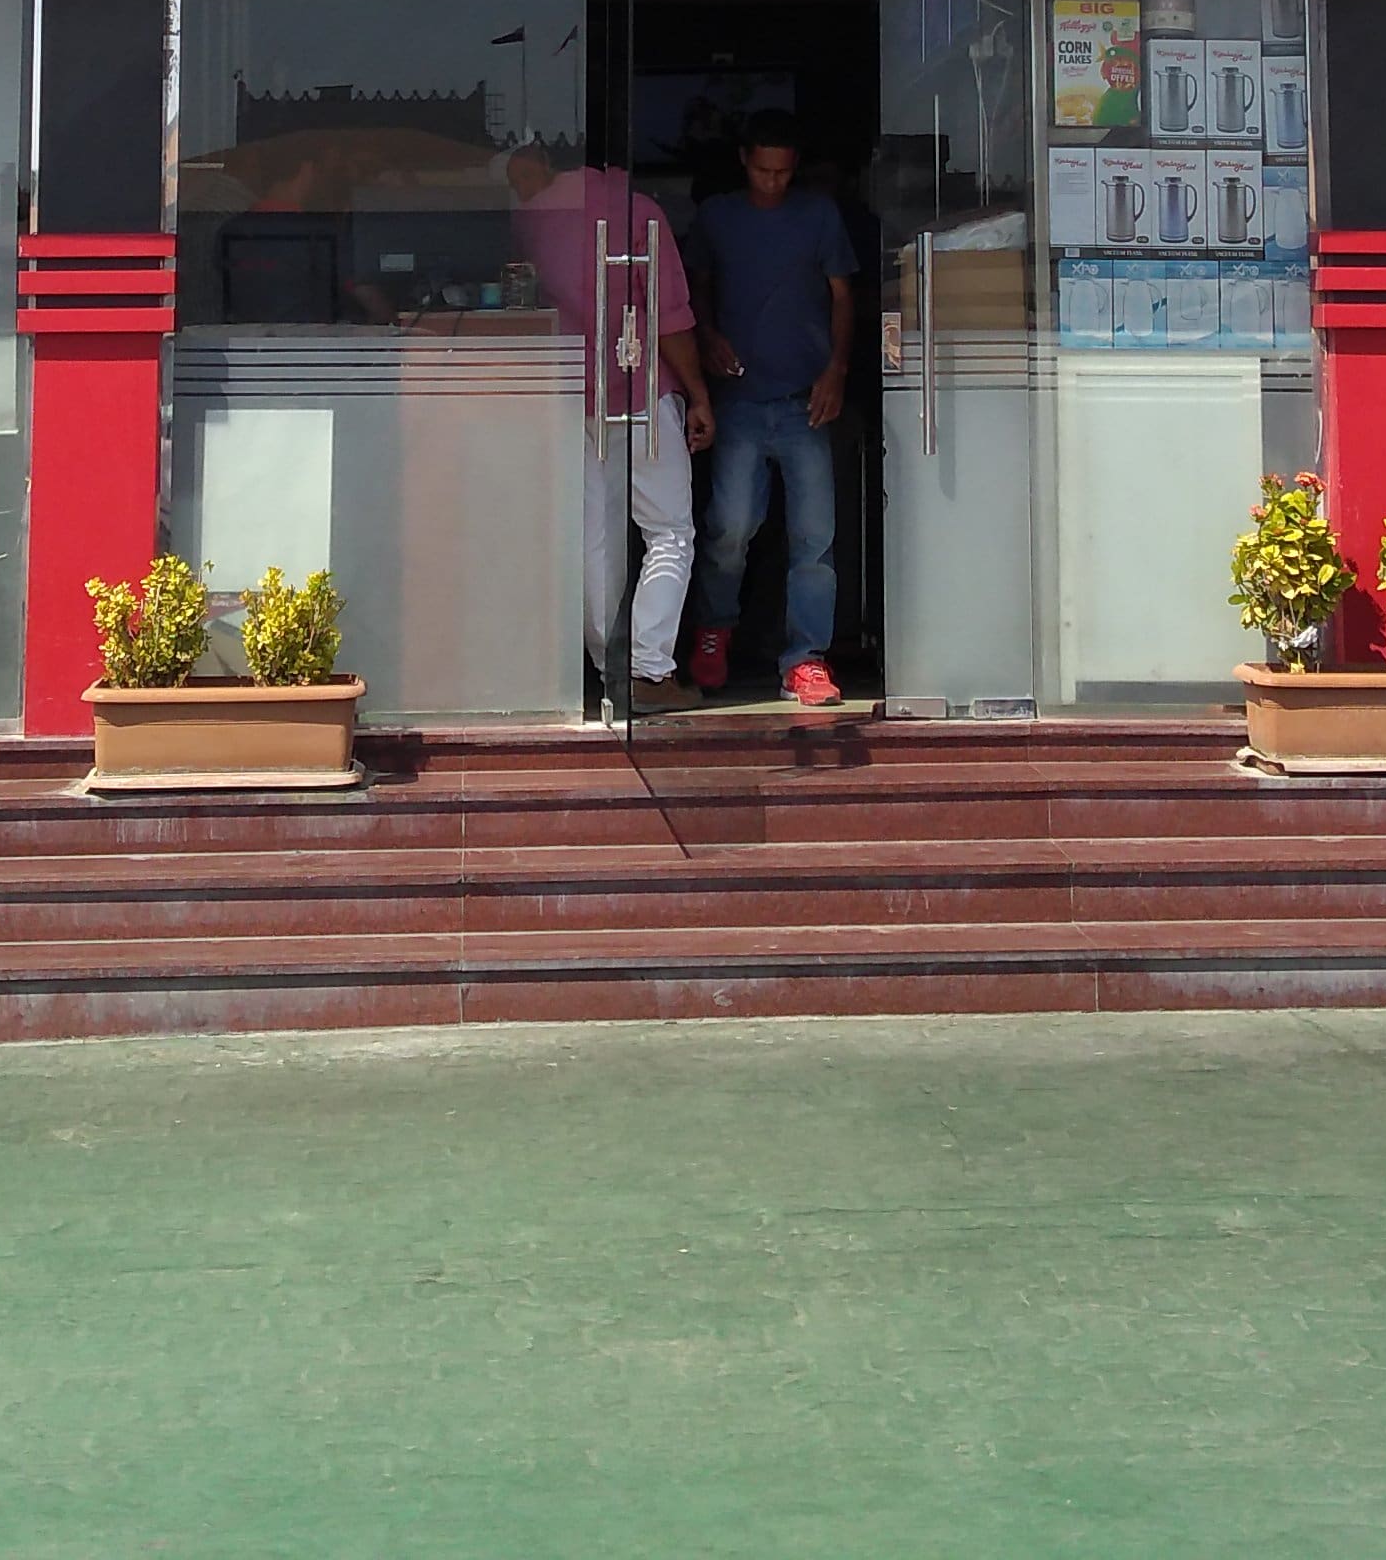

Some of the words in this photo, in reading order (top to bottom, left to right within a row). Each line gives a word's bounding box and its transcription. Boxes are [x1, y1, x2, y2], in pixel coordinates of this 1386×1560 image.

[1080, 2, 1115, 15] BIG
[1058, 40, 1092, 54] CORN
[1058, 54, 1092, 65] FLAKES
